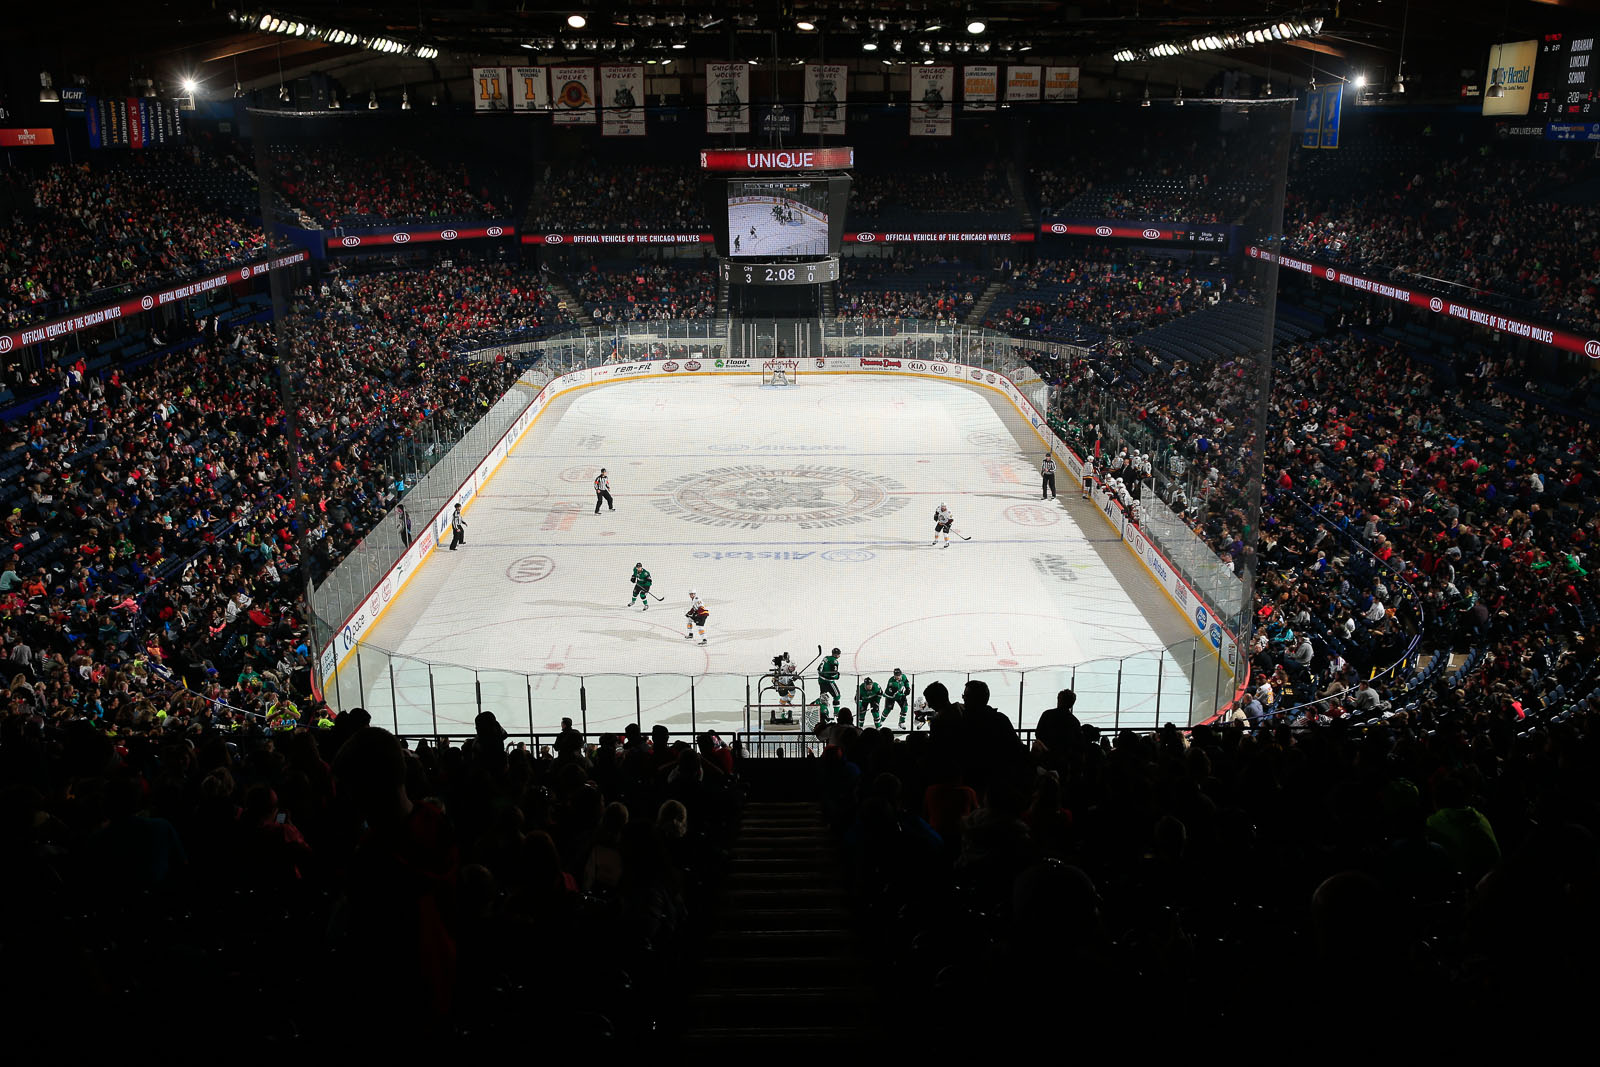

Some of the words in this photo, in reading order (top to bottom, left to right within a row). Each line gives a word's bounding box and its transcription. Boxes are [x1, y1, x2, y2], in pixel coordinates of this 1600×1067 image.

[1570, 55, 1589, 68] LINCOLN
[1507, 66, 1530, 83] Herald
[1568, 72, 1585, 84] SCHOOL
[62, 90, 83, 100] LIGHT
[480, 78, 502, 100] 11
[525, 78, 535, 100] 1
[109, 101, 118, 144] MARQUETTE
[747, 152, 814, 168] UNIQUE
[745, 274, 752, 283] 3
[808, 273, 814, 282] 0
[765, 269, 796, 281] 2:08
[158, 291, 175, 304] OFFICIAL
[175, 286, 189, 299] VEHICLE
[201, 279, 215, 291] CHICAGO
[215, 275, 228, 288] WOLVES
[1340, 273, 1353, 285] OFFICIAL
[1354, 277, 1367, 290] VEHICLE
[1380, 284, 1394, 297] CHICAGO
[1395, 289, 1410, 302] WOLVES
[22, 328, 45, 345] OFFICIAL
[46, 321, 66, 337] VEHICLE
[67, 320, 73, 333] OF
[74, 317, 84, 329] THE
[84, 312, 104, 327] CHICAGO
[104, 306, 121, 323] WOLVES
[1449, 304, 1469, 320] OFFICIAL
[1470, 310, 1489, 325] VEHICLE
[1490, 314, 1496, 326] OF
[1497, 317, 1507, 330] THE
[1507, 320, 1530, 337] CHICAGO
[1531, 327, 1554, 343] WOLVES
